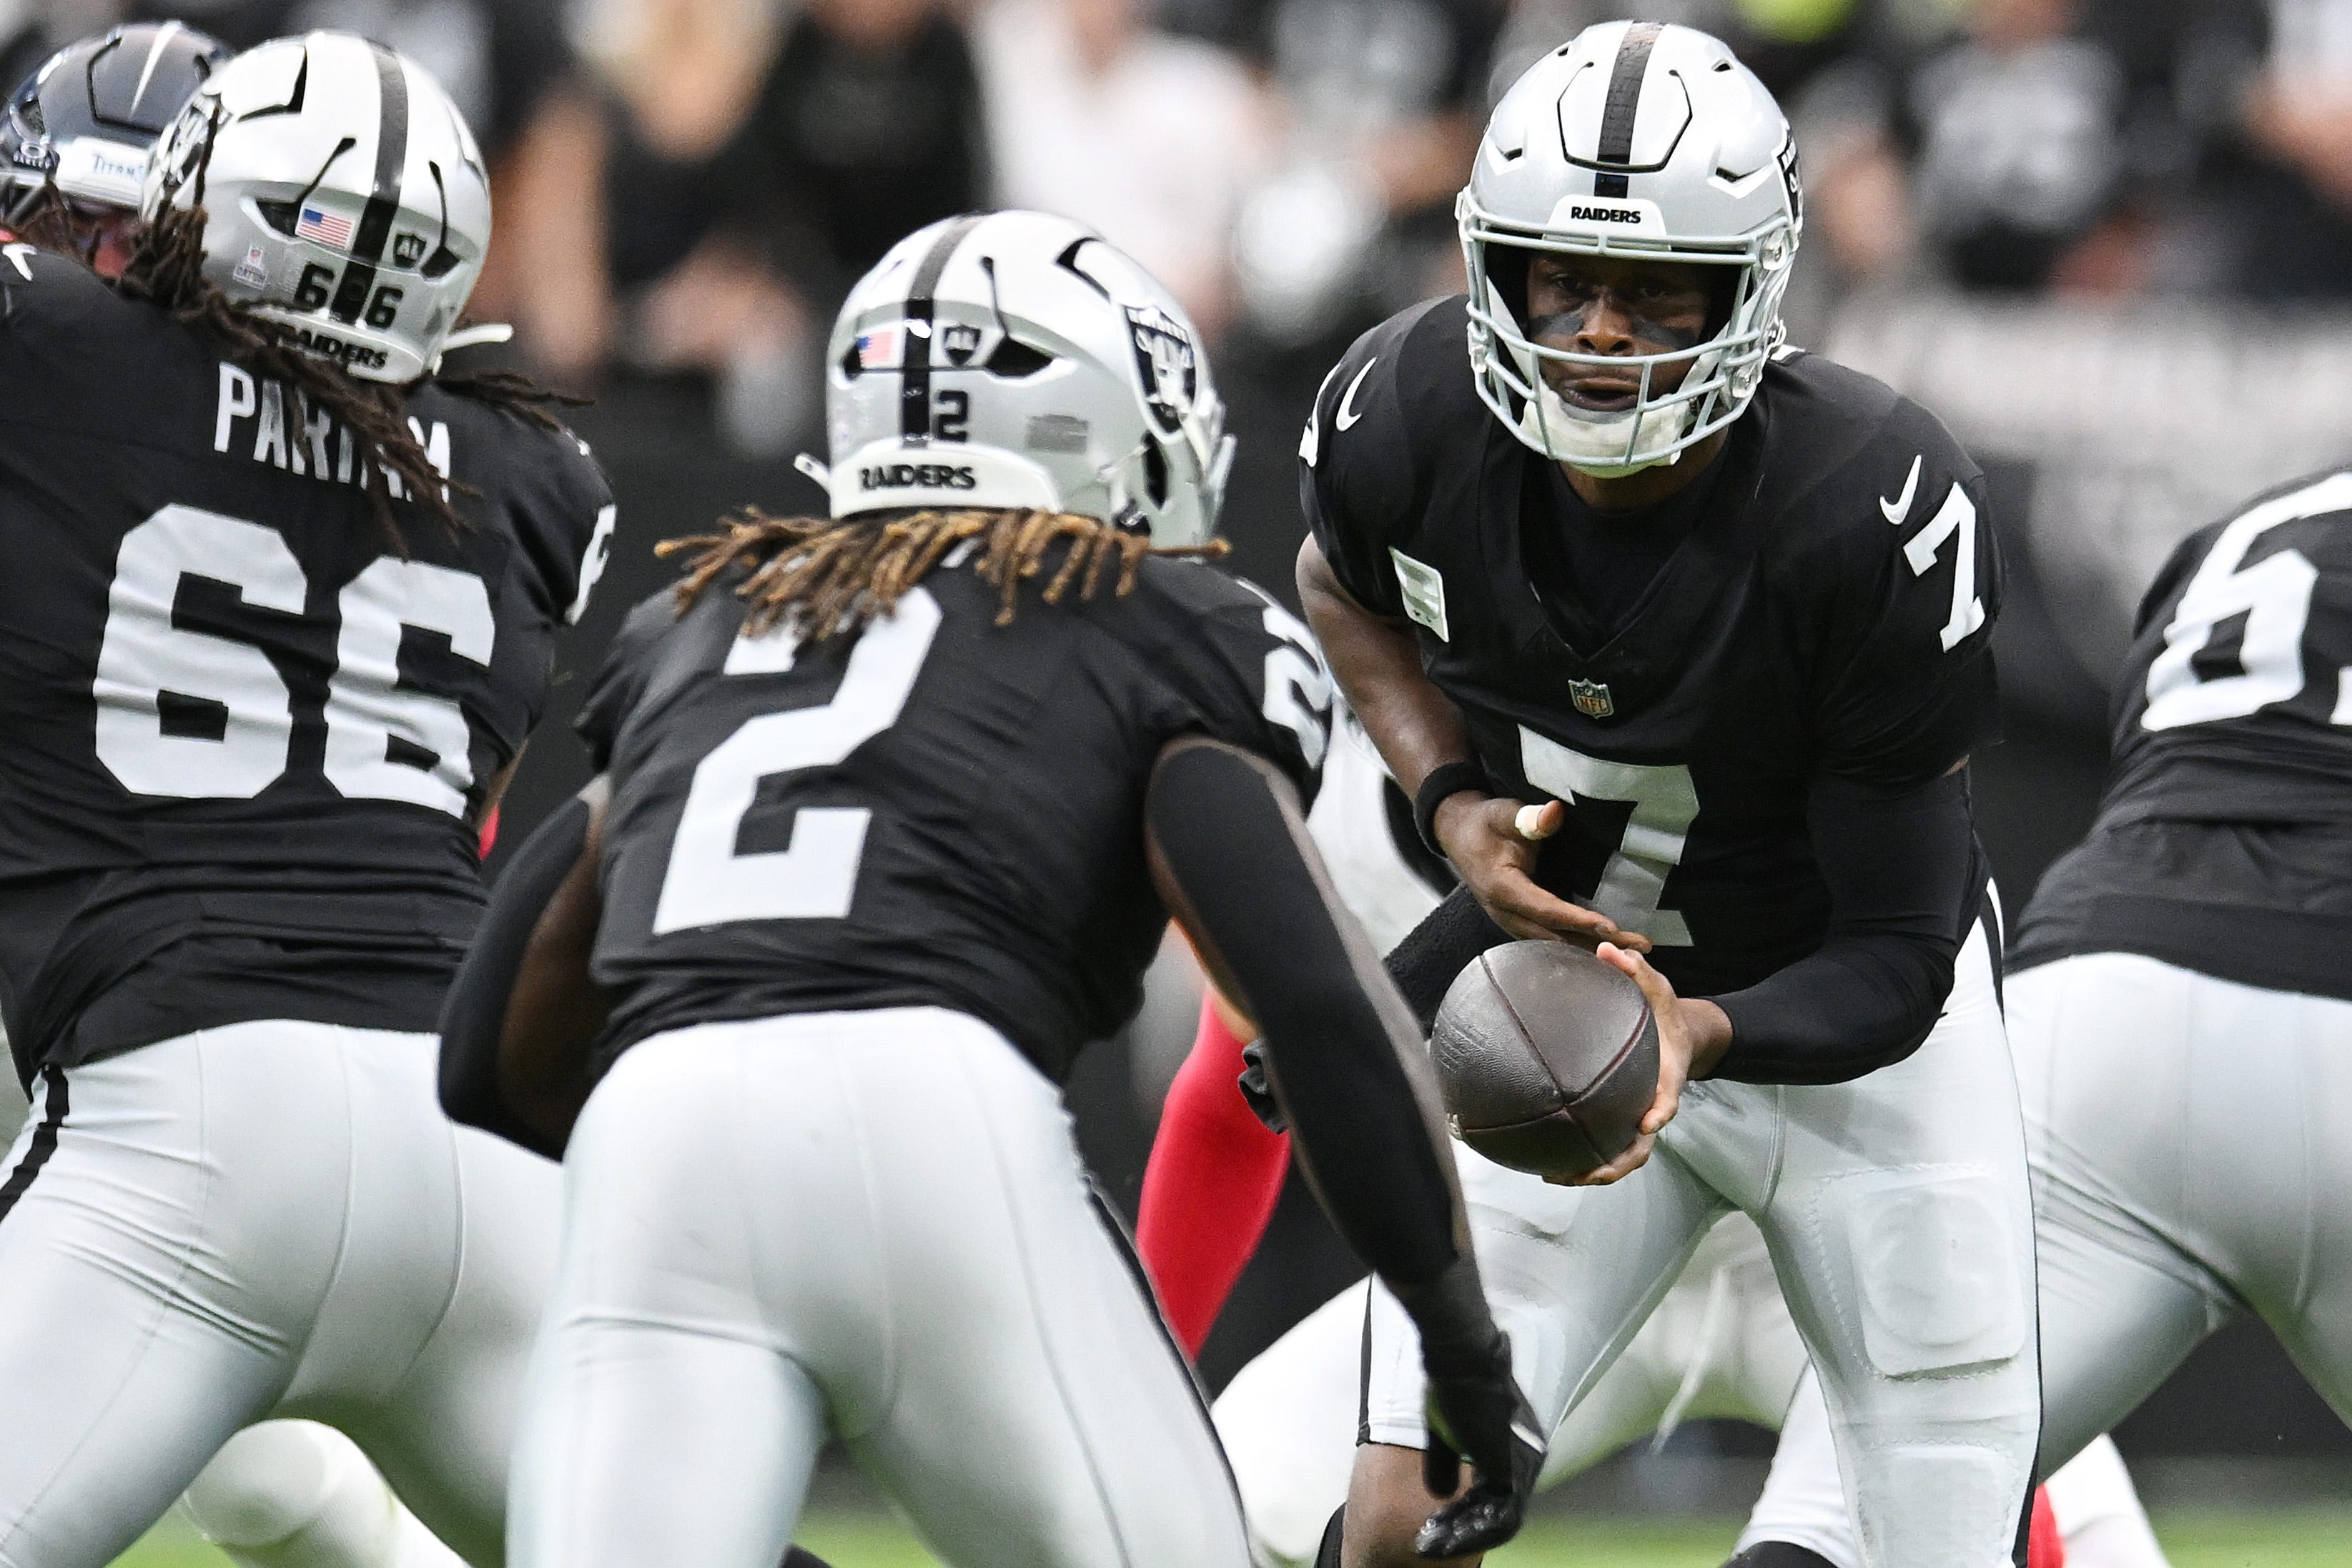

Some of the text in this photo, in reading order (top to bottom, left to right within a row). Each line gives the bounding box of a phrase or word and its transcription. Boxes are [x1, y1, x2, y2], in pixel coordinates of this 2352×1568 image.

[294, 264, 404, 329] 66
[1571, 206, 1641, 224] RAIDERS
[287, 327, 388, 370] AIDERS
[937, 390, 969, 442] 2
[1903, 481, 1987, 653] 7
[93, 502, 496, 820] 66
[1262, 607, 1334, 770] 2
[653, 585, 944, 935] 2
[1518, 723, 1700, 947] 7
